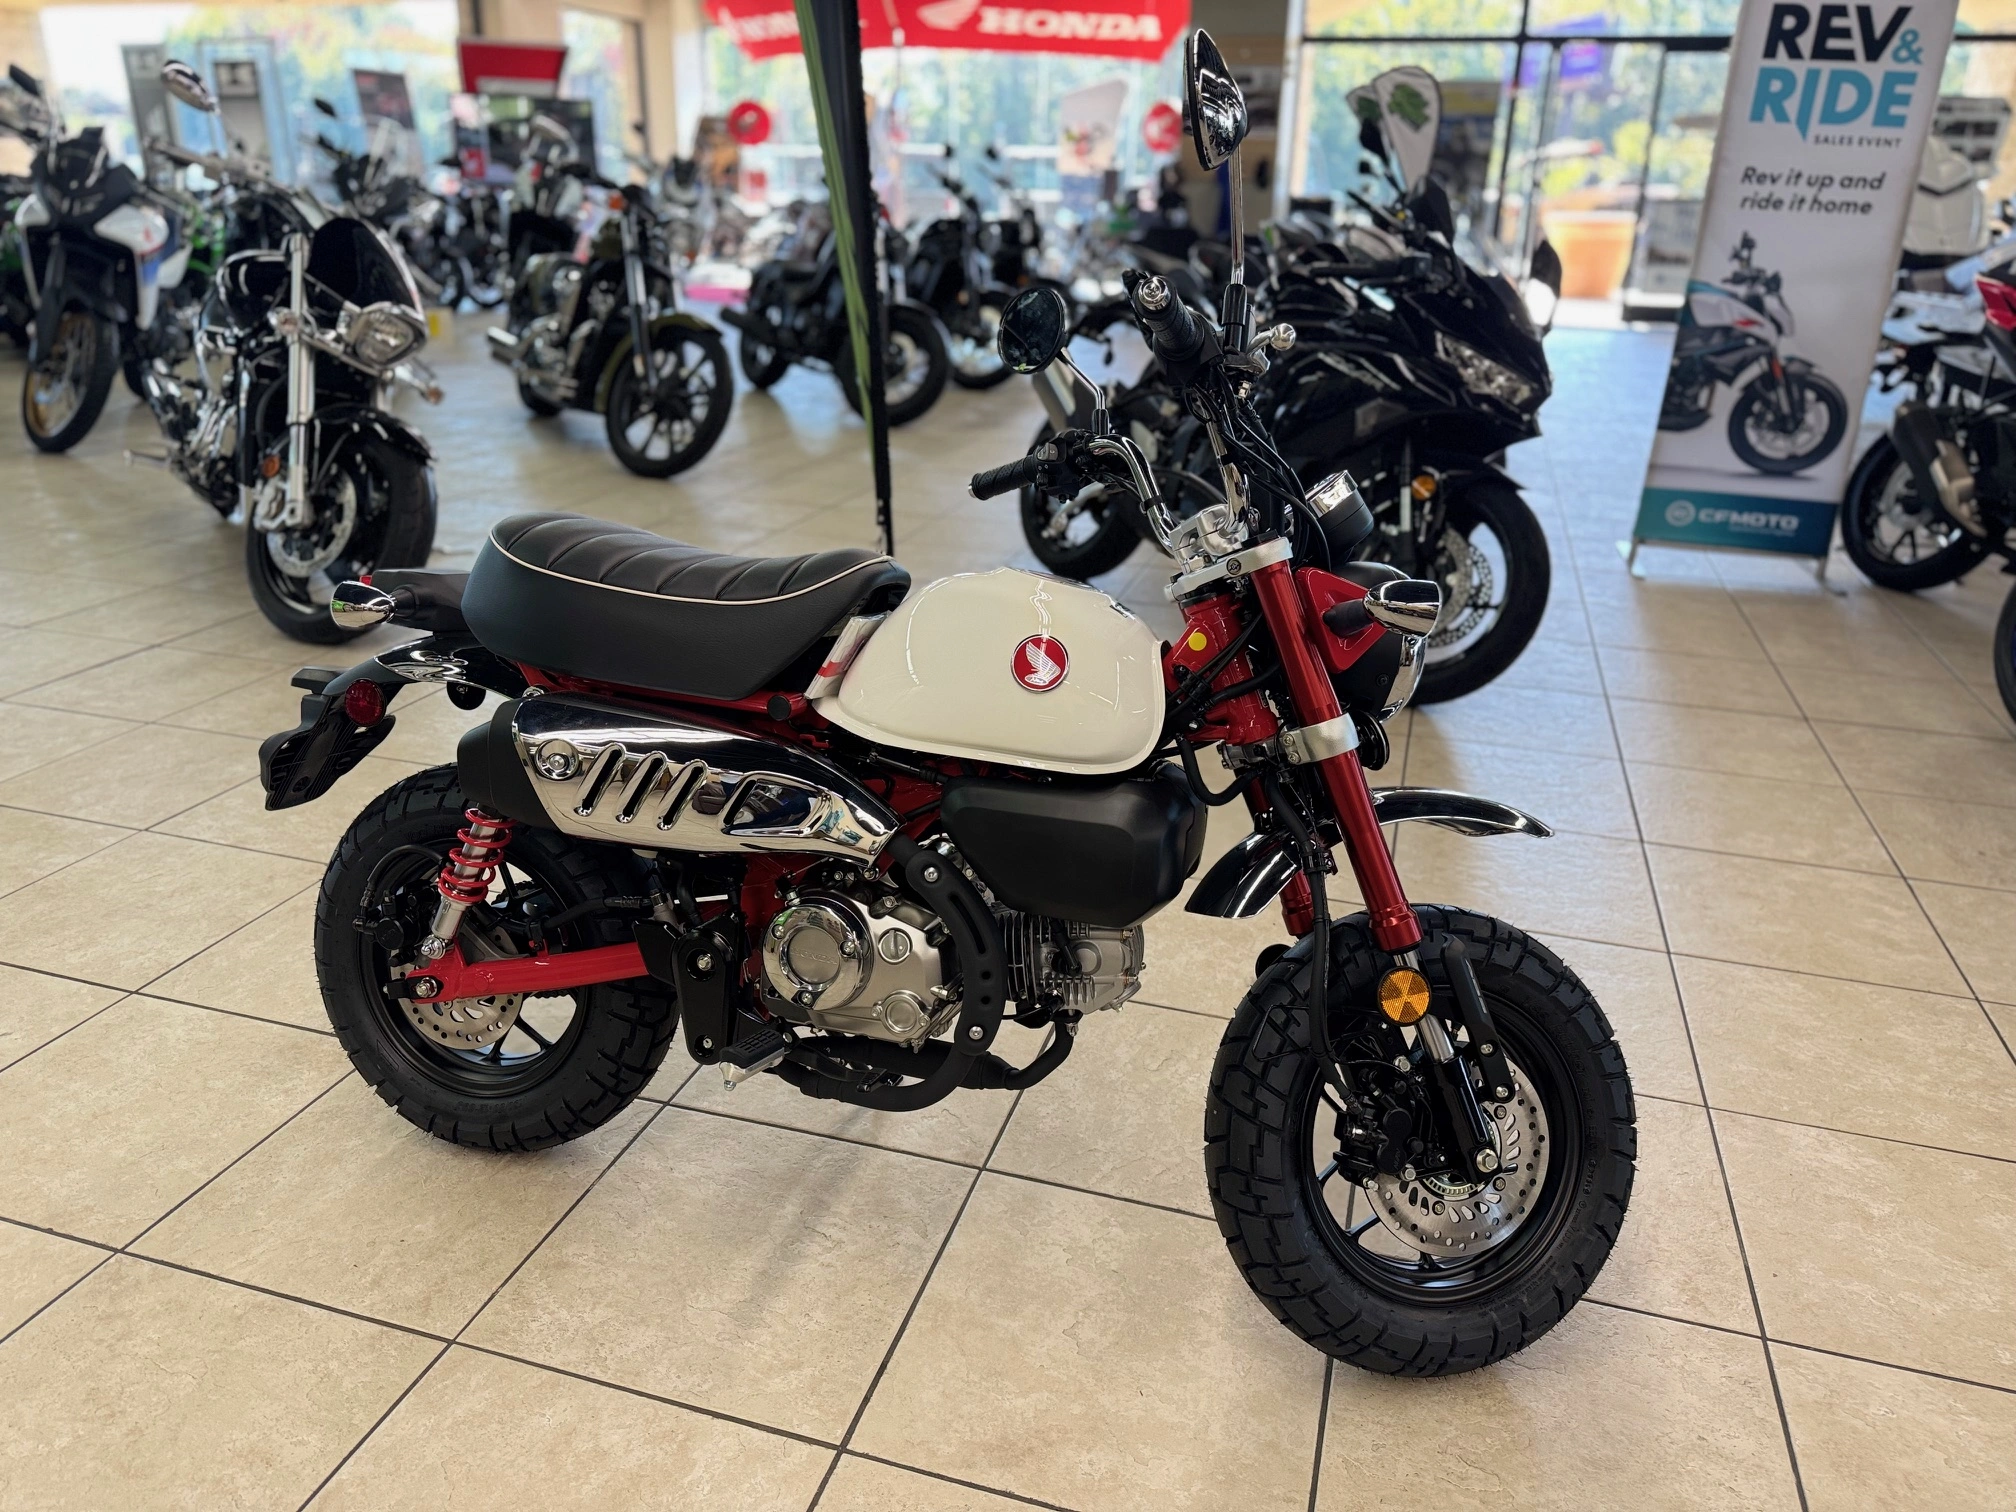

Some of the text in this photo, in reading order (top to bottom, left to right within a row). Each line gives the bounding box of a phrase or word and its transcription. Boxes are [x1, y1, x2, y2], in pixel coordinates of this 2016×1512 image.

[977, 6, 1163, 42] HONDA
[1749, 66, 1918, 142] RIDE
[1814, 134, 1902, 149] SALES EVENT
[1740, 166, 1886, 192] Rev it up and
[1740, 191, 1873, 215] ride it home
[1699, 508, 1799, 531] CFMOTO
